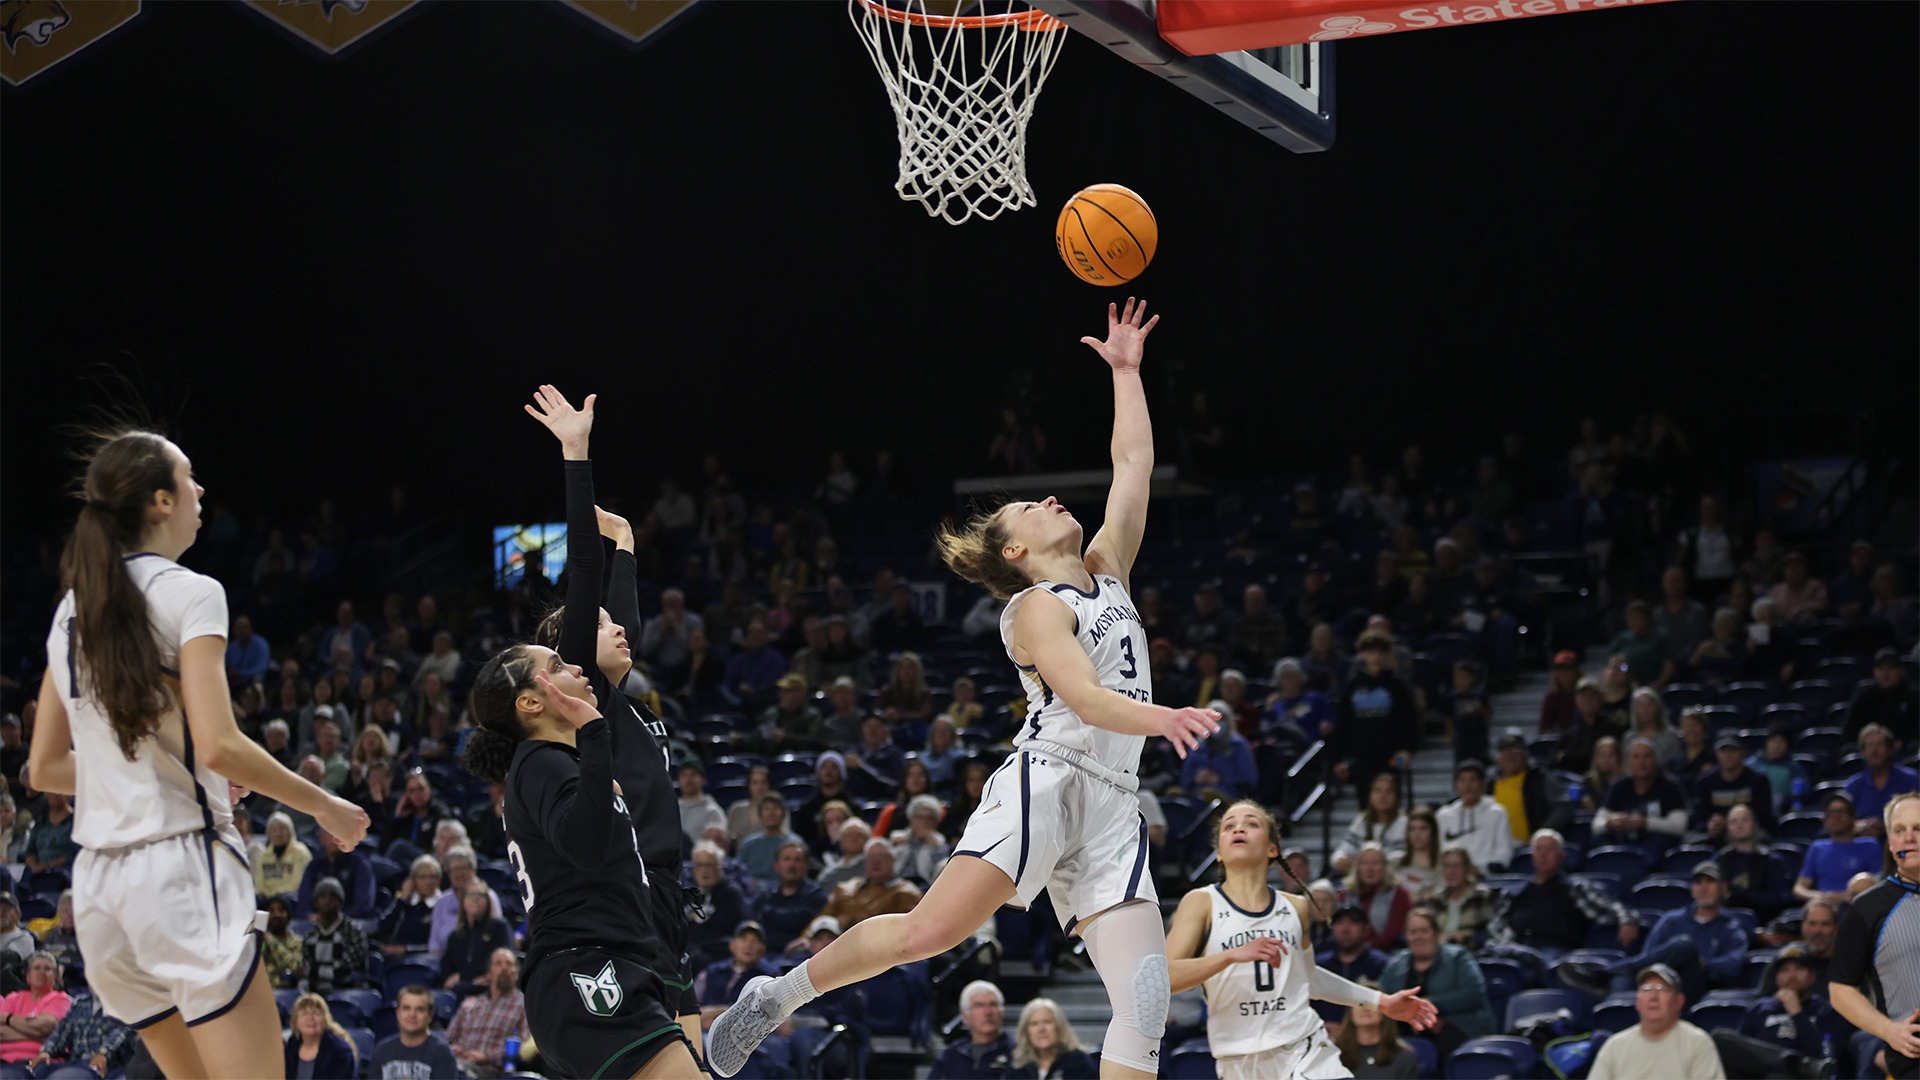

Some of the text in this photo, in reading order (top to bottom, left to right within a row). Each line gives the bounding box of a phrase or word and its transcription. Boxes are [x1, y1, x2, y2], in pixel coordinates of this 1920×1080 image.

[1399, 0, 1557, 27] State
[1120, 635, 1138, 679] 3
[572, 963, 621, 1013] PS
[1254, 959, 1274, 992] 0
